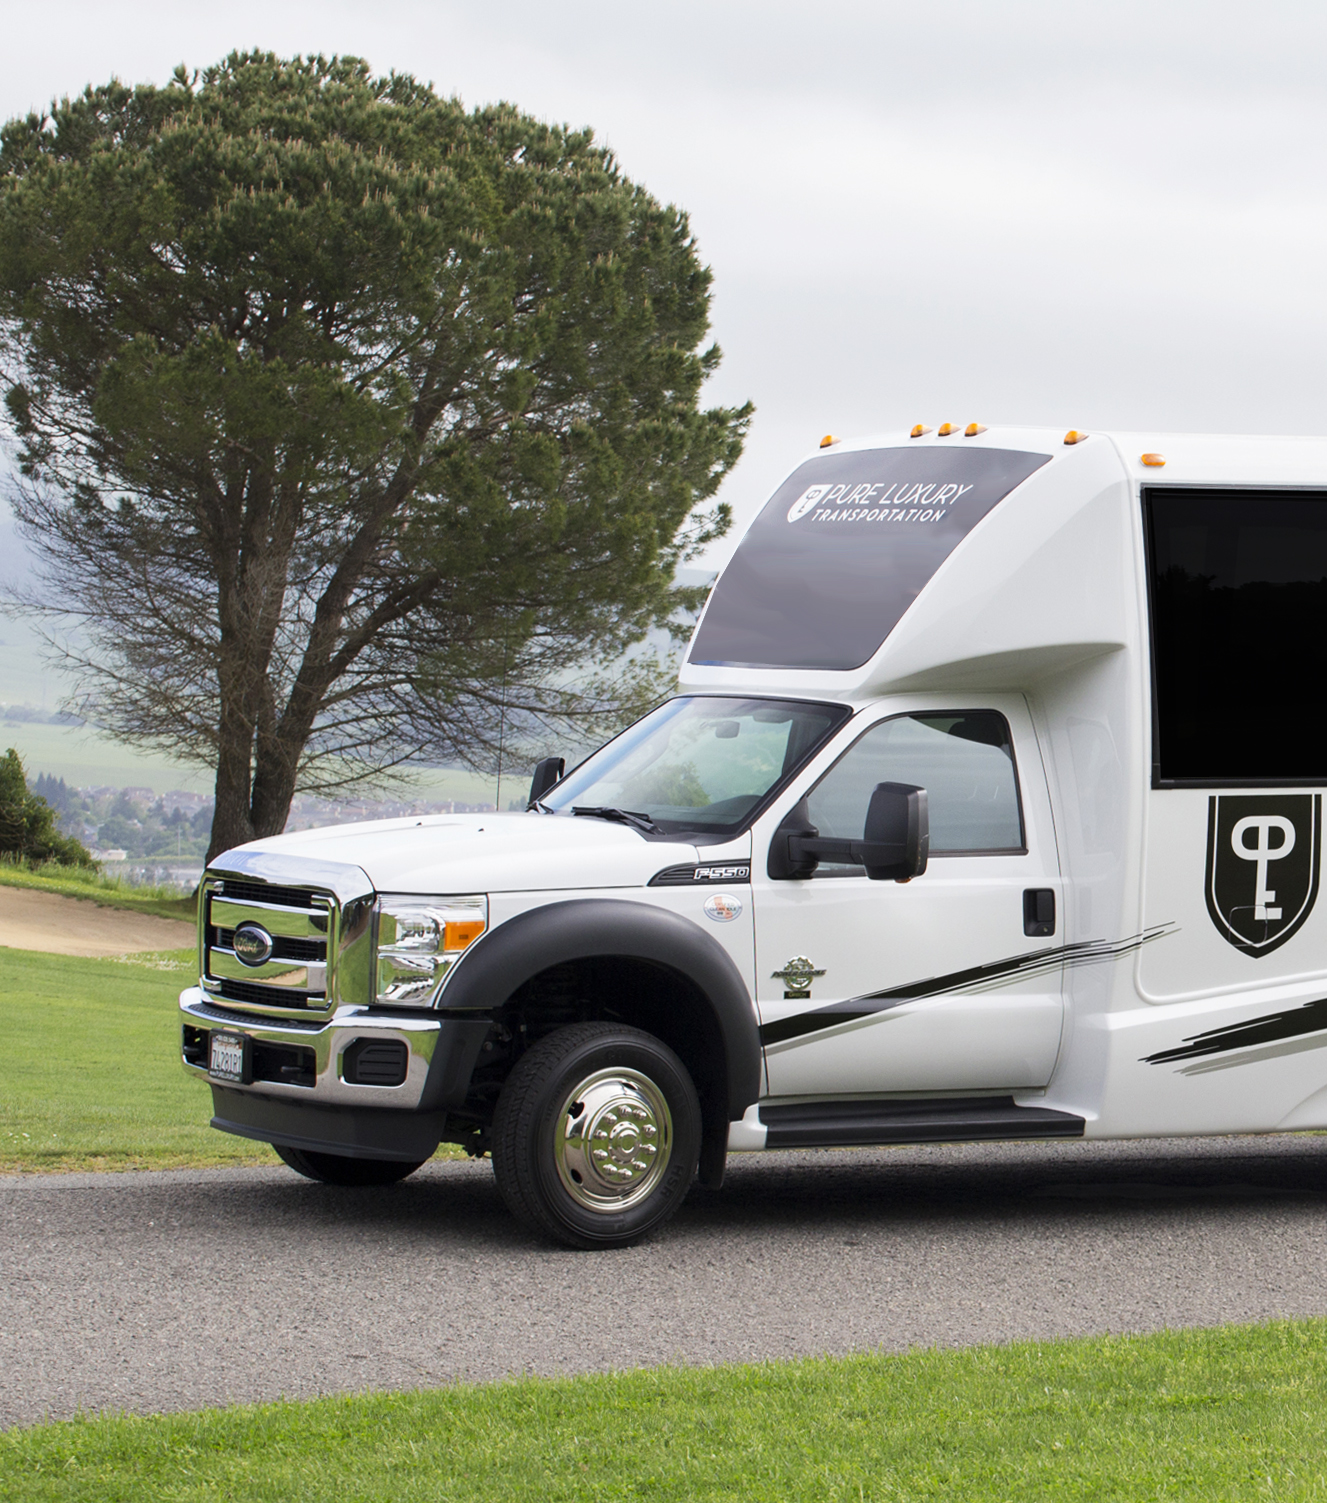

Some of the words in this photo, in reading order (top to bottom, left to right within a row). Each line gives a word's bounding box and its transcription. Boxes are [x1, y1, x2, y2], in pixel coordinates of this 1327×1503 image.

[822, 483, 885, 504] PURE
[878, 483, 974, 505] LUXURY
[811, 508, 946, 522] TRANSPORTATION
[693, 867, 749, 879] F-550
